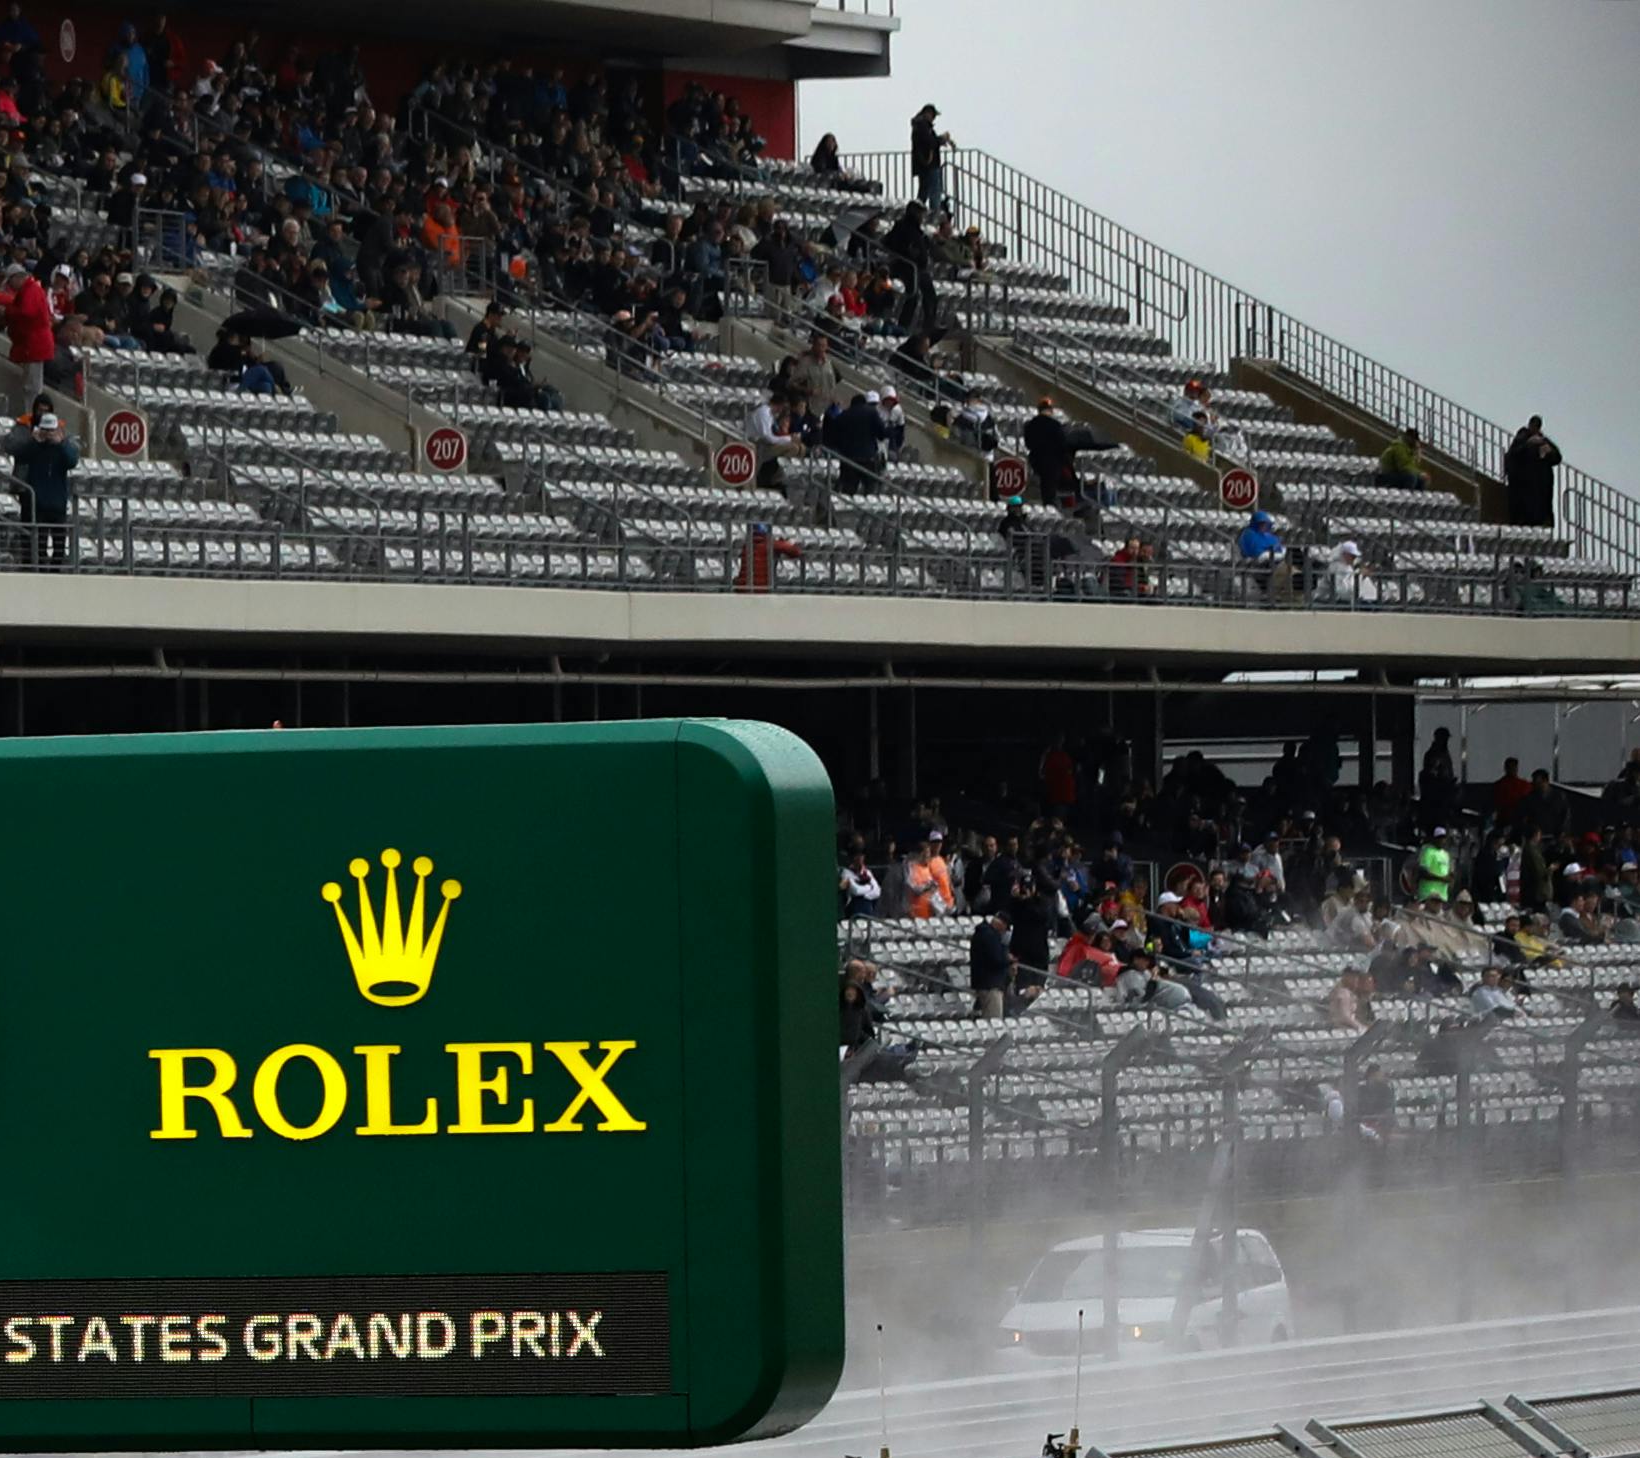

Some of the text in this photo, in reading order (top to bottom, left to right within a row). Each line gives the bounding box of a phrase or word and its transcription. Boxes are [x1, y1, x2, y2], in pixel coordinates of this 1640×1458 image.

[110, 424, 141, 446] 208
[433, 440, 460, 461] 207
[723, 455, 750, 476] 206
[997, 466, 1023, 489] 205
[1226, 479, 1252, 500] 204
[149, 1041, 647, 1141] ROLEX
[3, 1315, 229, 1362] STATES
[243, 1312, 457, 1361] GRAND
[470, 1311, 606, 1358] PRIX
